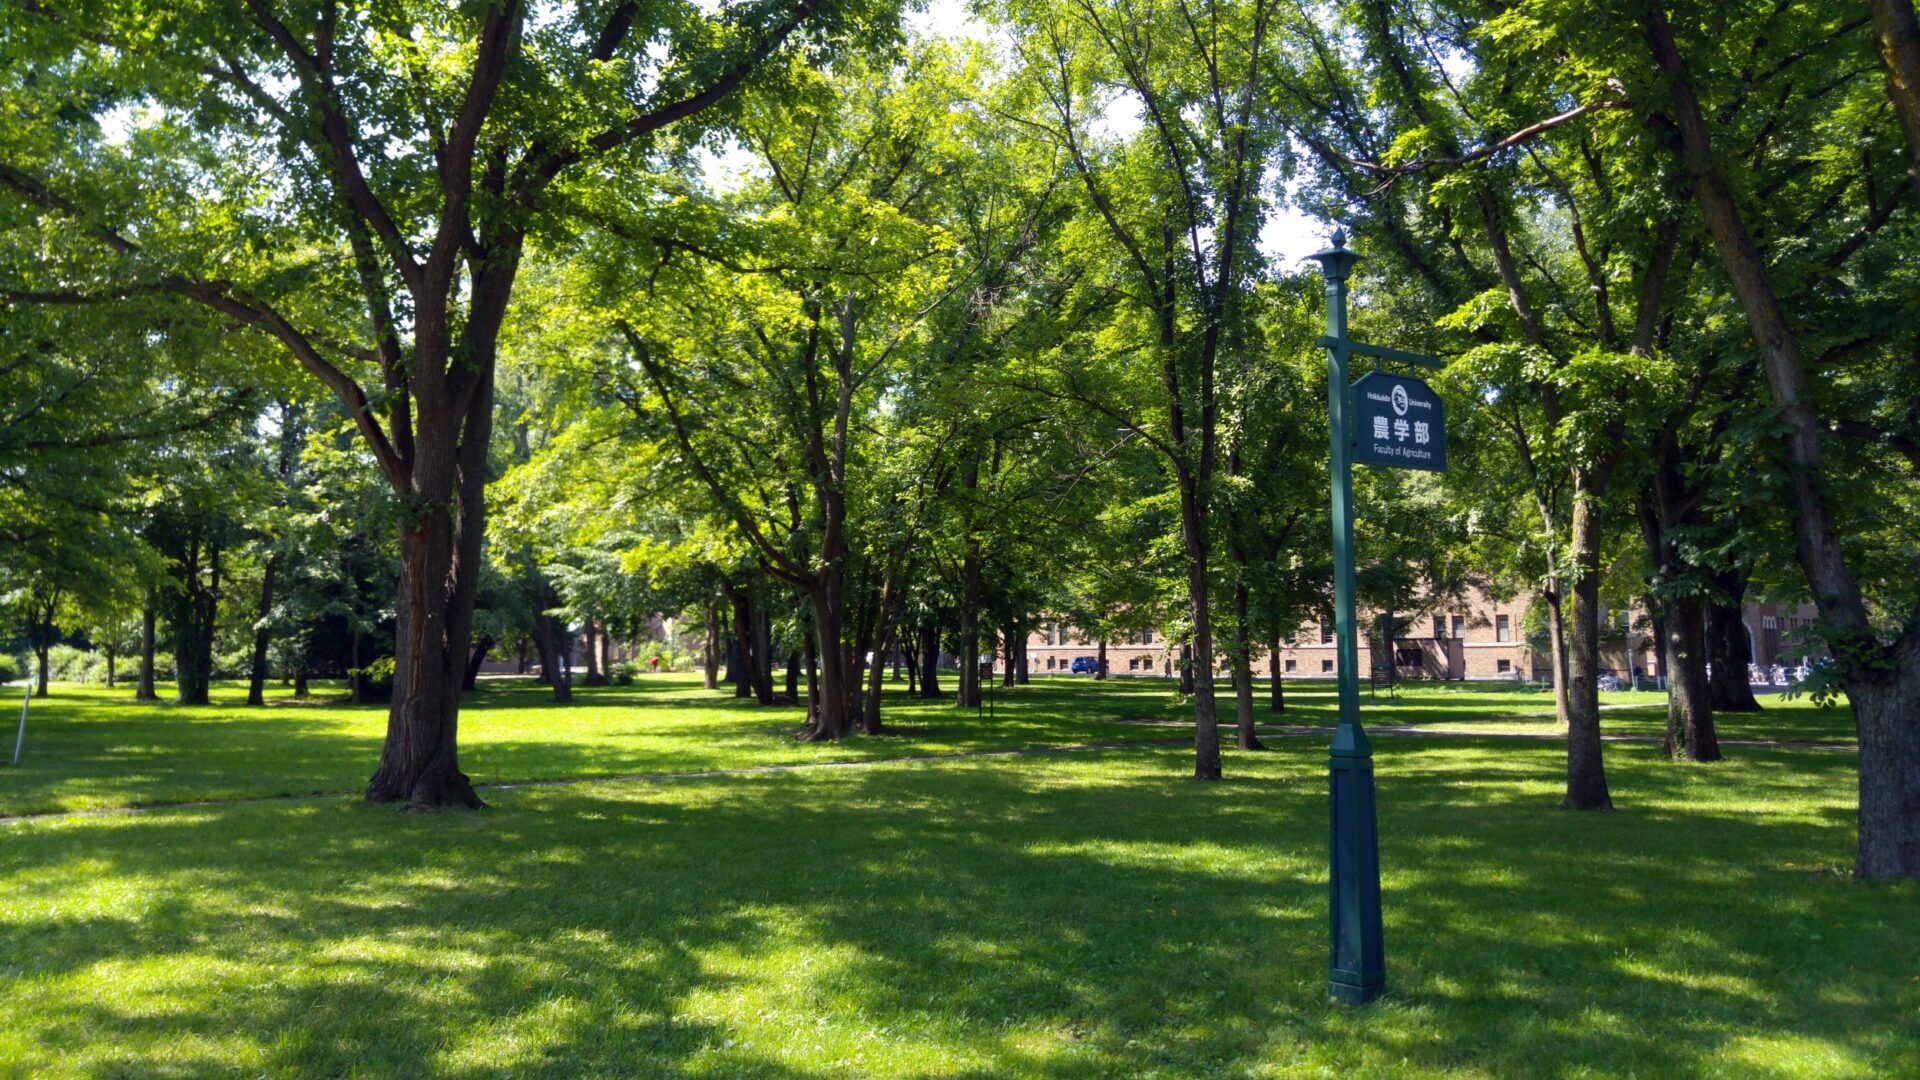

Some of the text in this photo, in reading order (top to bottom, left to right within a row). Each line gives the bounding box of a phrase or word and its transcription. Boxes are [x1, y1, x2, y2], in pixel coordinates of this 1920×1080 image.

[1367, 392, 1432, 410] Hokkaido University
[1373, 415, 1430, 444] 農学部
[1374, 443, 1431, 459] Faculty of Agriculture
